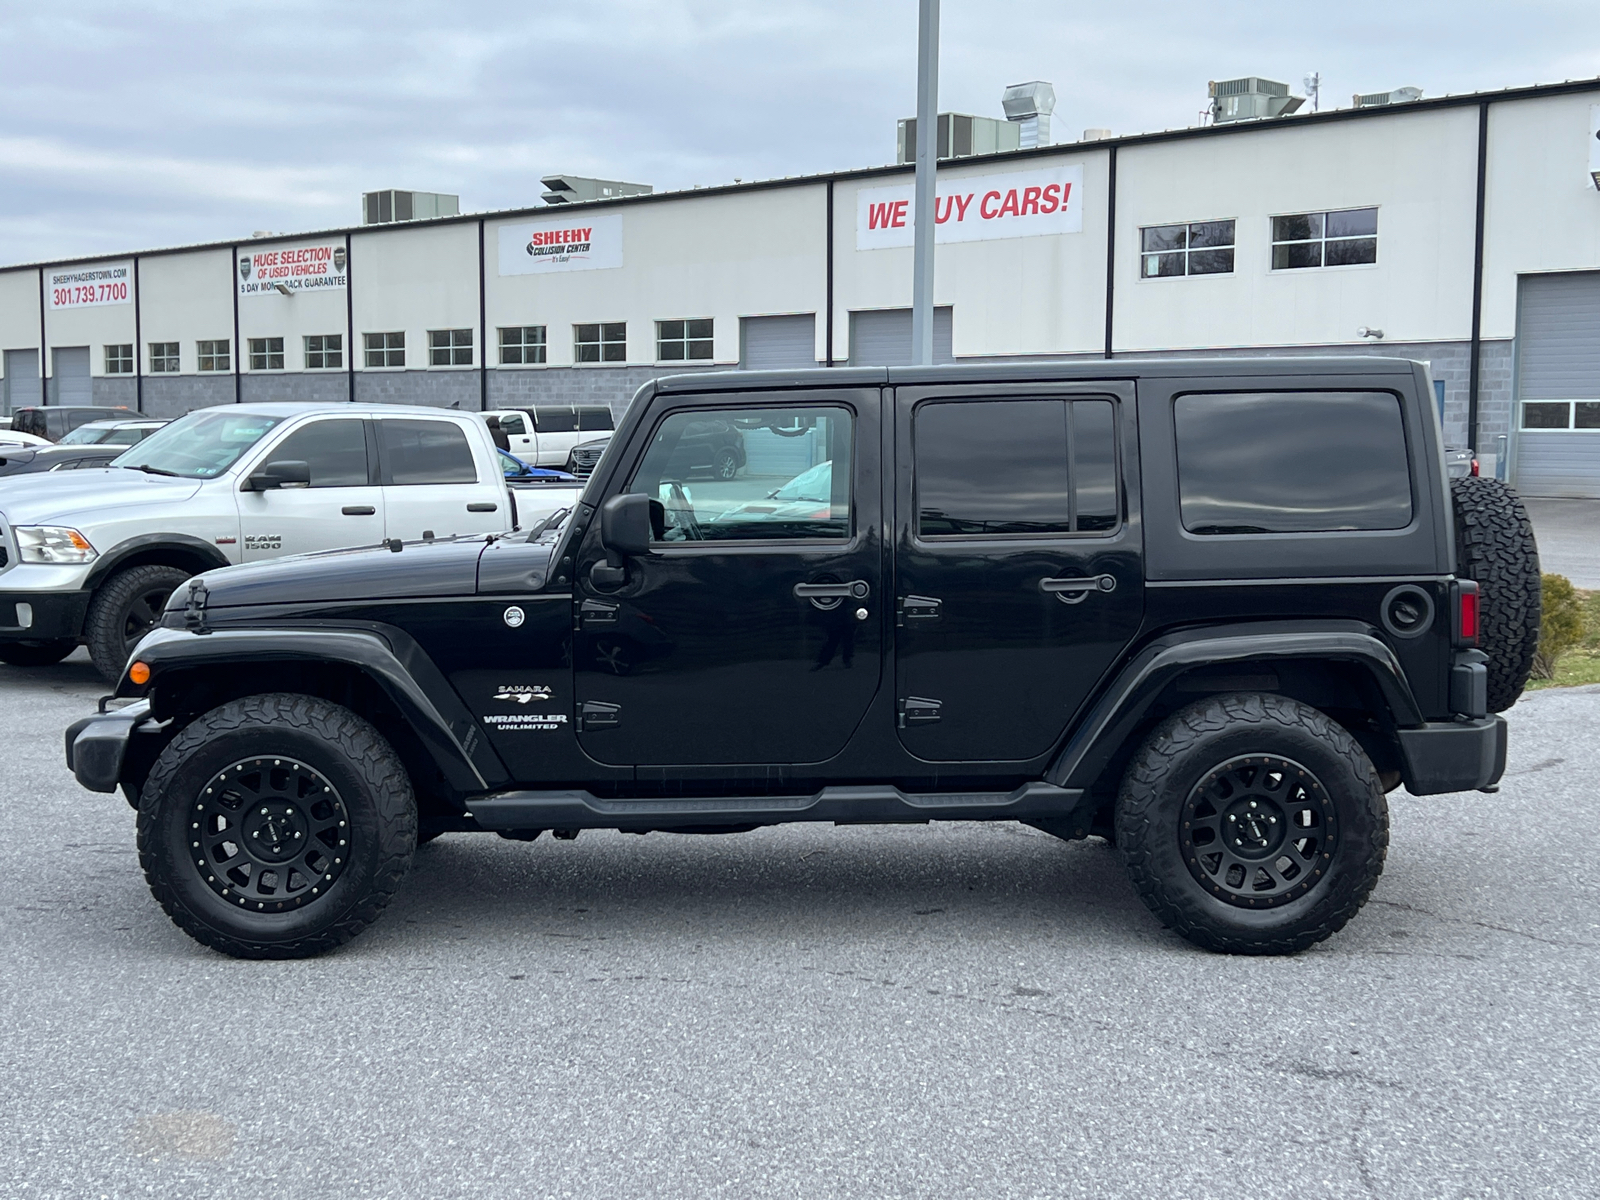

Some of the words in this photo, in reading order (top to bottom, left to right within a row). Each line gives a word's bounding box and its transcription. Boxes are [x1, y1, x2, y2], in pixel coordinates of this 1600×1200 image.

[868, 200, 909, 230] WE
[914, 193, 975, 226] UY
[979, 182, 1072, 220] CARS!
[532, 227, 592, 246] SHEEHY
[253, 252, 279, 268] HUGE
[280, 247, 332, 265] SELECTION
[533, 244, 566, 256] COLLISION
[566, 242, 591, 254] CENTER
[53, 268, 127, 285] SHEEHYHAGERSTOWN.COM
[257, 268, 268, 279] OF
[269, 265, 290, 279] USED
[290, 262, 328, 277] VEHICLES
[241, 284, 246, 293] 5
[246, 282, 260, 293] DAY
[304, 275, 346, 288] GUARANTEE
[53, 282, 127, 306] 301.739.7700
[245, 534, 282, 542] RAM
[245, 542, 282, 550] 1500
[498, 685, 552, 693] SAHARA
[483, 714, 568, 723] WRANGLER
